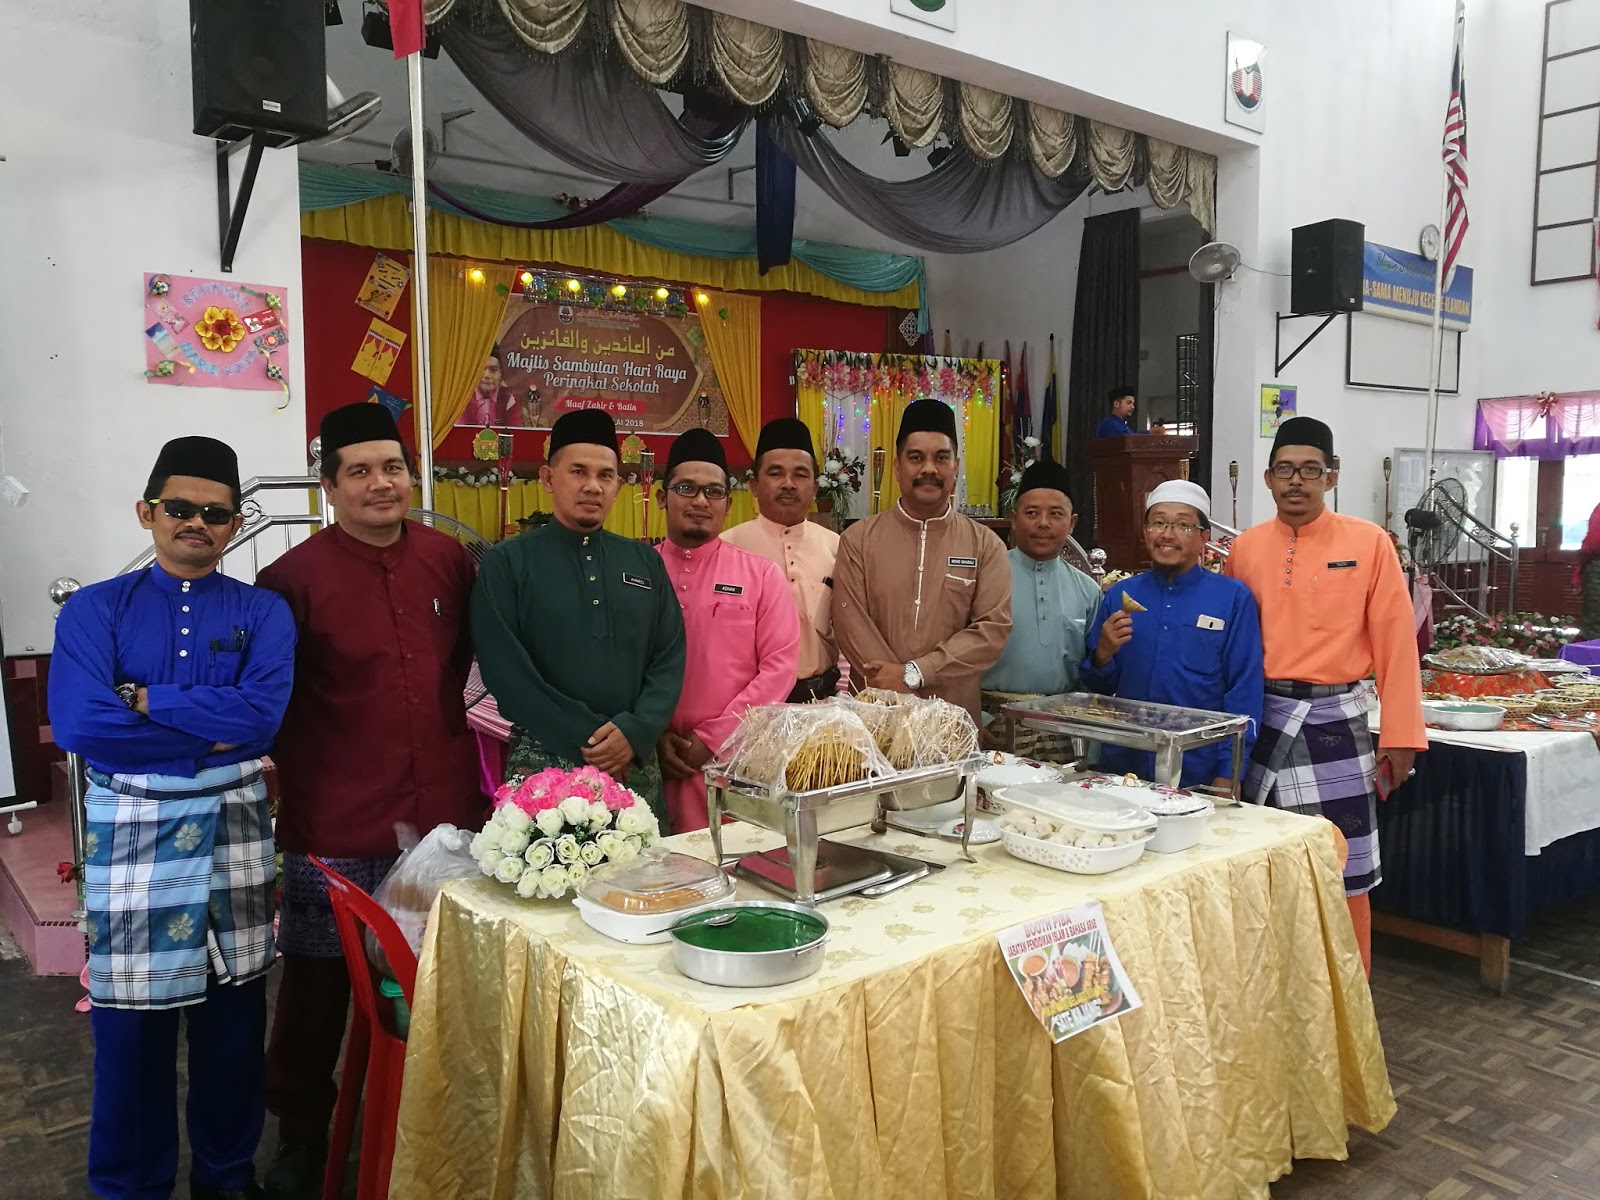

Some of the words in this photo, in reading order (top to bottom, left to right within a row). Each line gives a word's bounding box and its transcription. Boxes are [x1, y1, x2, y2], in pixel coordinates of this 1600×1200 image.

[1393, 285, 1419, 306] MENUJU
[1420, 291, 1470, 316] KECEERLANGAN
[593, 335, 650, 355] العائدين
[656, 345, 675, 360] من
[506, 352, 549, 373] Majlis
[552, 355, 619, 376] Sambutan
[623, 360, 651, 378] Hari
[654, 363, 688, 384] Raya
[543, 372, 608, 393] Peringkat
[611, 376, 660, 394] Sekolah
[565, 399, 586, 410] Maaf
[587, 400, 607, 410] Zahir
[616, 402, 637, 411] Batin
[624, 419, 644, 427] 2018
[1024, 916, 1052, 938] BOOTH
